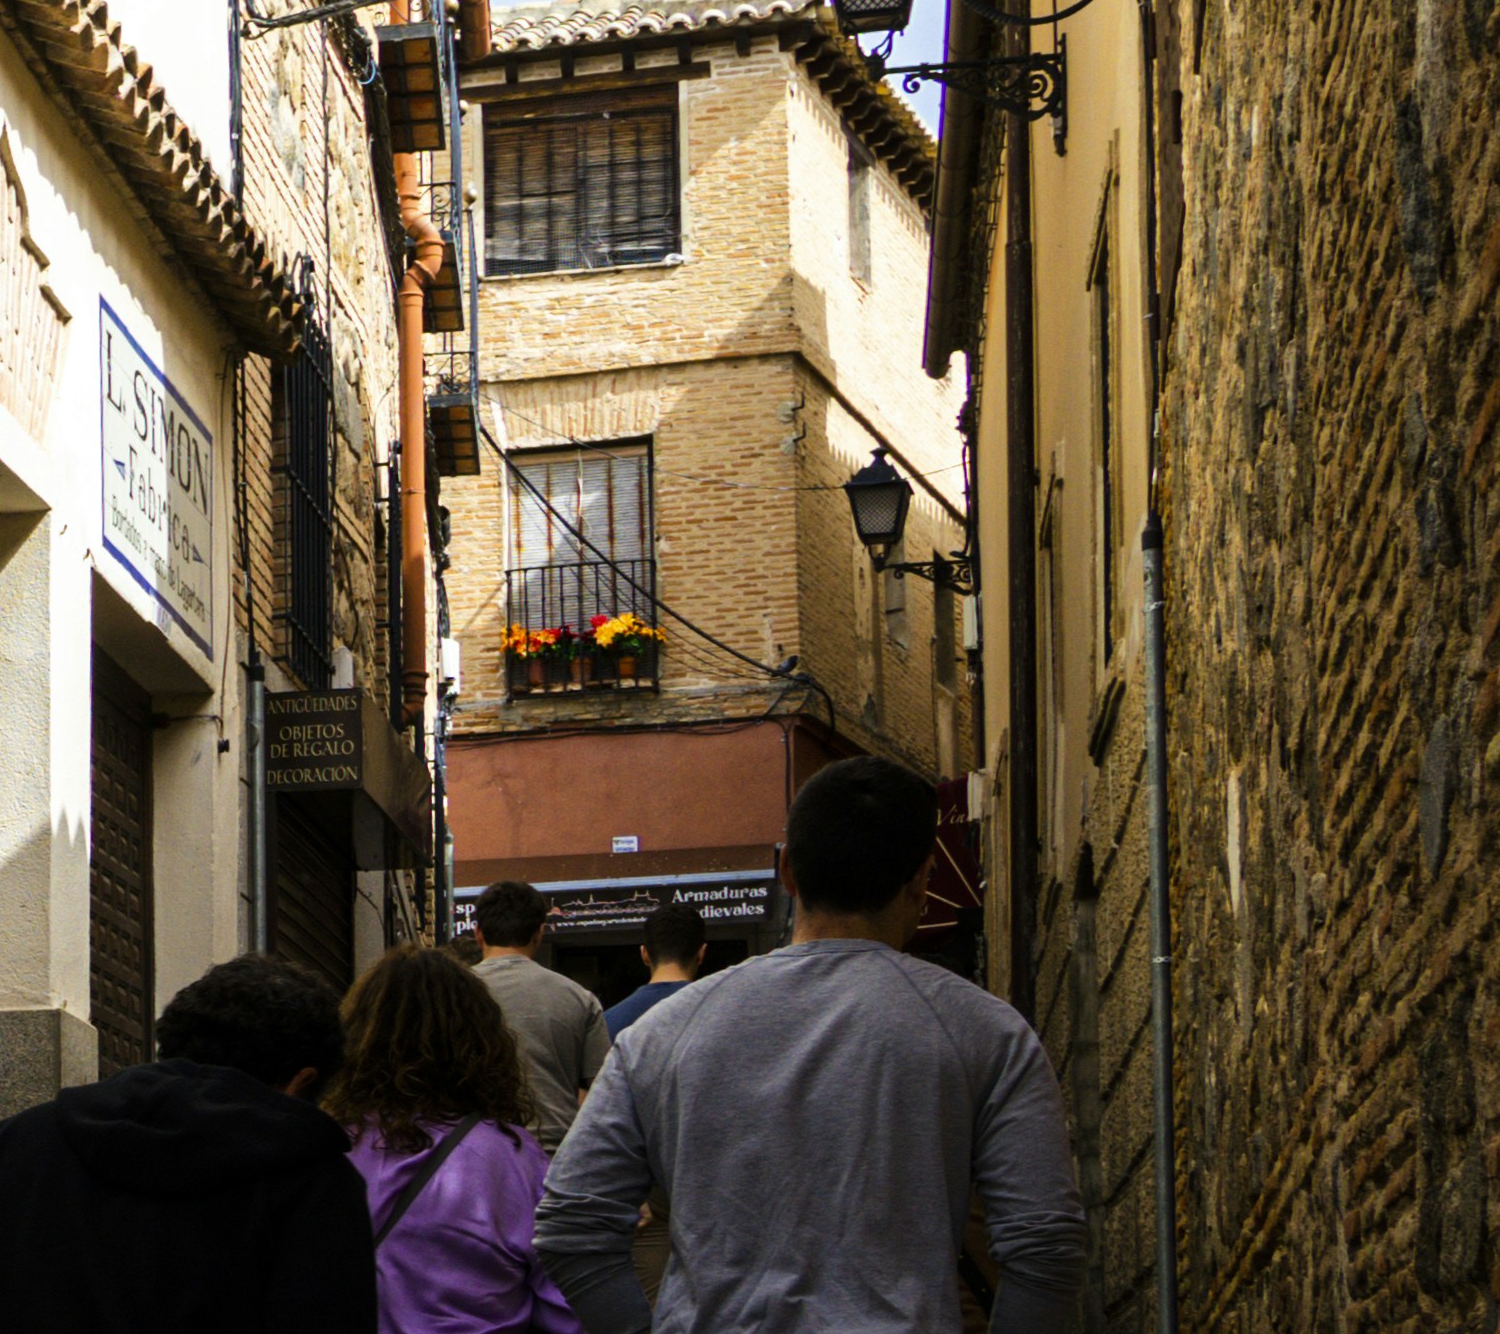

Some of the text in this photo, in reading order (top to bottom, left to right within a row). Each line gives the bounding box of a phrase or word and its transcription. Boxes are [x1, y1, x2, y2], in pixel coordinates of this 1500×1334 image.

[106, 329, 209, 516] L. SIMON
[267, 695, 358, 715] ANTIGÜEDADES
[279, 723, 345, 742] OBJETOS
[270, 739, 355, 759] DE REGALO
[671, 886, 769, 904] Armaduras
[698, 902, 766, 920] dievales
